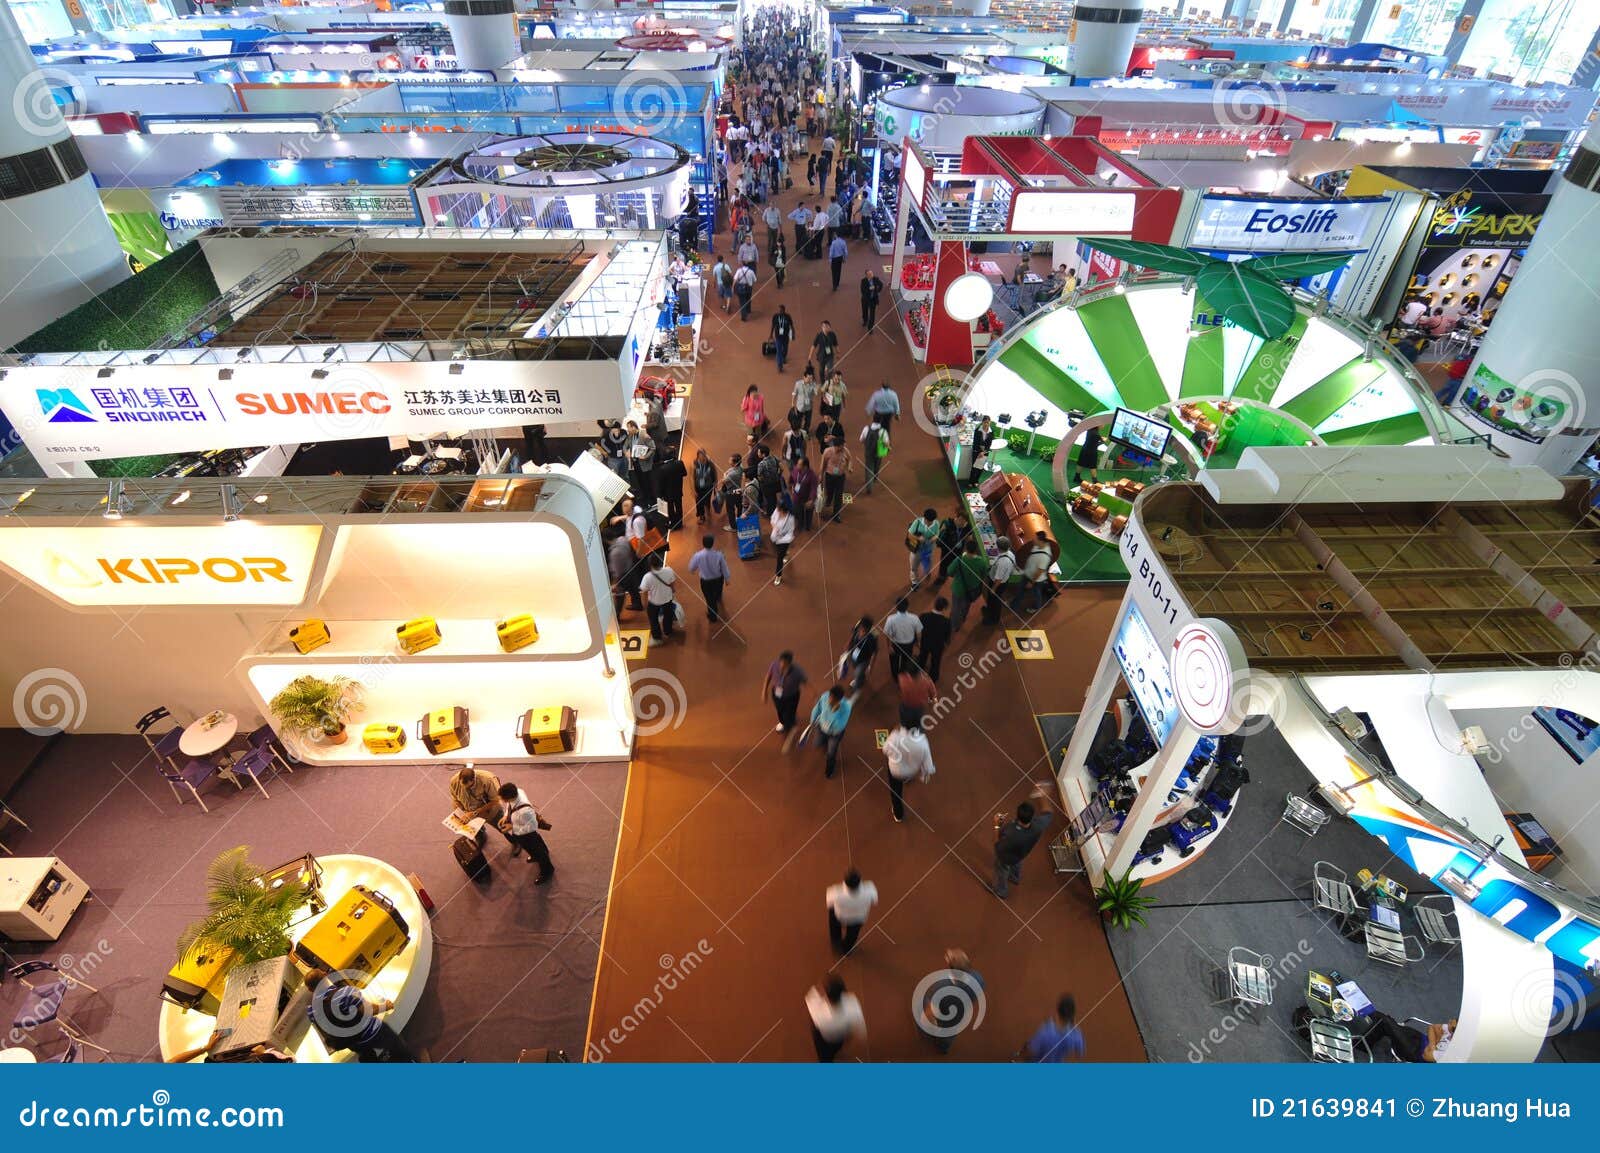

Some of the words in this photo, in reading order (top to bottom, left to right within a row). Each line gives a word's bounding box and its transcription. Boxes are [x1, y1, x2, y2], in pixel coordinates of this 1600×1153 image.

[180, 217, 224, 227] BLUESKY
[1244, 208, 1338, 233] Eoslift
[91, 388, 199, 408] 国机集团
[235, 391, 392, 415] SUMEC
[404, 389, 561, 405] 江苏苏美达集团公司
[105, 411, 206, 422] SINOMACH
[409, 408, 446, 416] SUMEC
[488, 407, 563, 415] CORPORATION
[96, 558, 293, 583] KIPOR
[1139, 558, 1178, 624] B10-11
[1015, 637, 1043, 652] B
